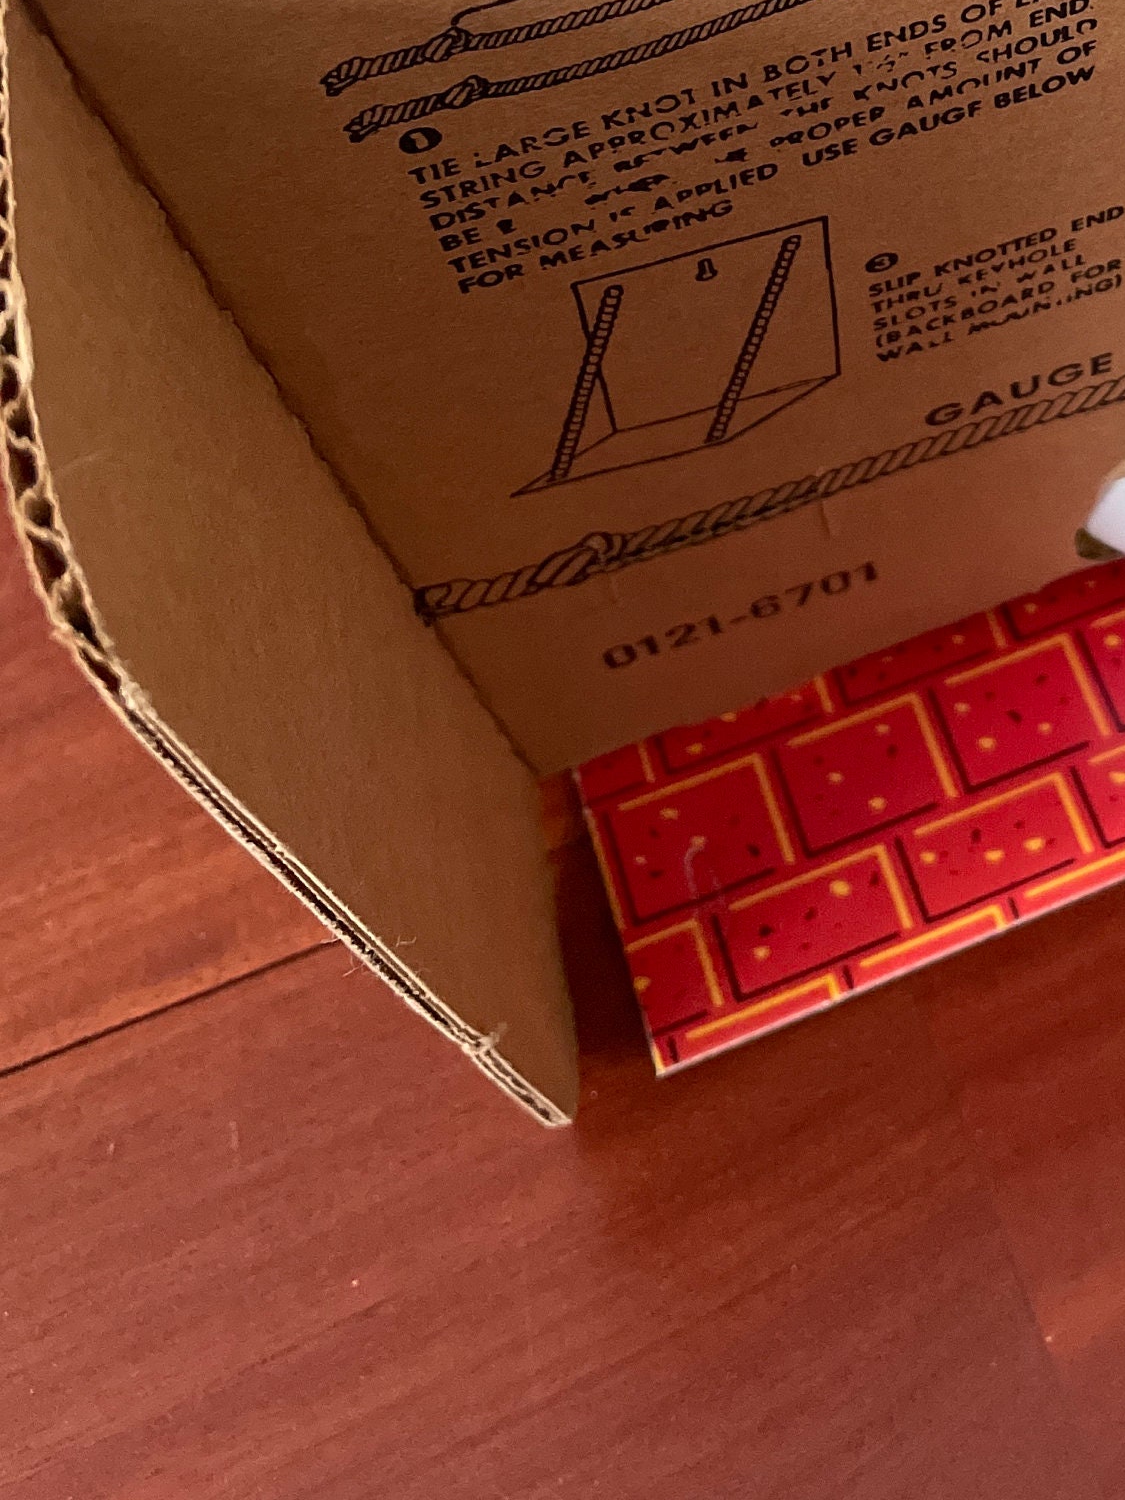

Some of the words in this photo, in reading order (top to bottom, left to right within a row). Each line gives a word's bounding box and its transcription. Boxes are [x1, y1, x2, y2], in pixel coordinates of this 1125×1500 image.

[408, 158, 461, 185] TIE
[474, 121, 591, 168] LARGE
[601, 88, 697, 130] KNOT
[712, 72, 749, 99] IN
[763, 42, 852, 83] BOTH
[867, 14, 947, 52] ENDS
[419, 161, 546, 209] STRING
[924, 20, 1013, 60] FROM
[438, 227, 483, 253] BE
[1056, 40, 1098, 64] OF
[447, 219, 596, 274] TENSION
[653, 163, 778, 211] APPLIED
[801, 138, 858, 167] USE
[868, 100, 983, 147] GAUGE
[994, 65, 1096, 109] BELOW
[457, 264, 524, 294] FOR
[869, 271, 921, 297] SLIP
[934, 228, 1057, 277] KNOTTED
[1071, 206, 1125, 232] END
[1070, 259, 1122, 283] FOR
[871, 283, 943, 314] THRU
[873, 295, 957, 331] SLOTS
[923, 352, 1115, 428] GAUGE
[602, 560, 877, 669] 0121-6701
